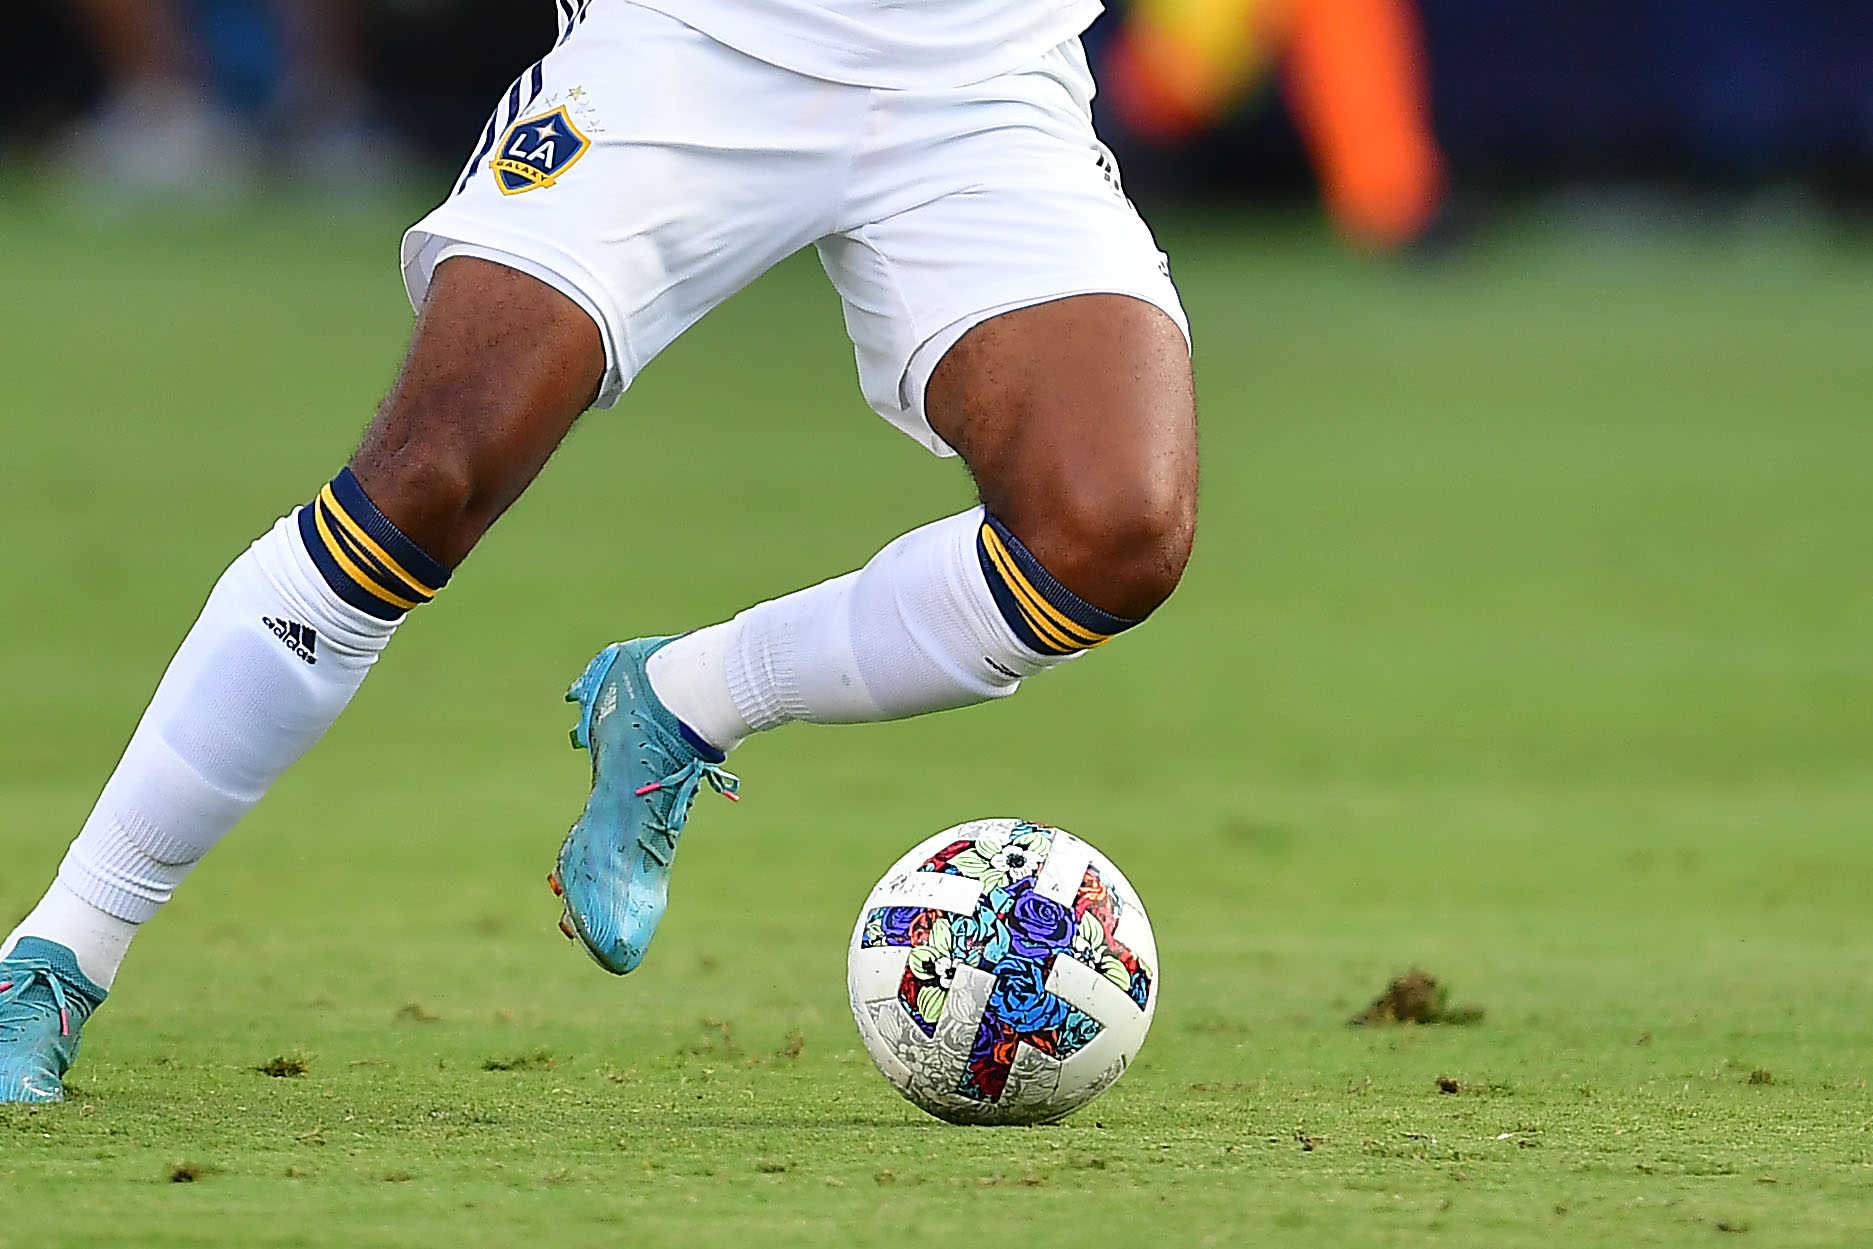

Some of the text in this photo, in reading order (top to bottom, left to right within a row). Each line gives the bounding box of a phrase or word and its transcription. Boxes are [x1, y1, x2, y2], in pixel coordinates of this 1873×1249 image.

[508, 133, 555, 169] LA
[496, 160, 547, 182] GALAXY
[262, 616, 318, 665] adidas
